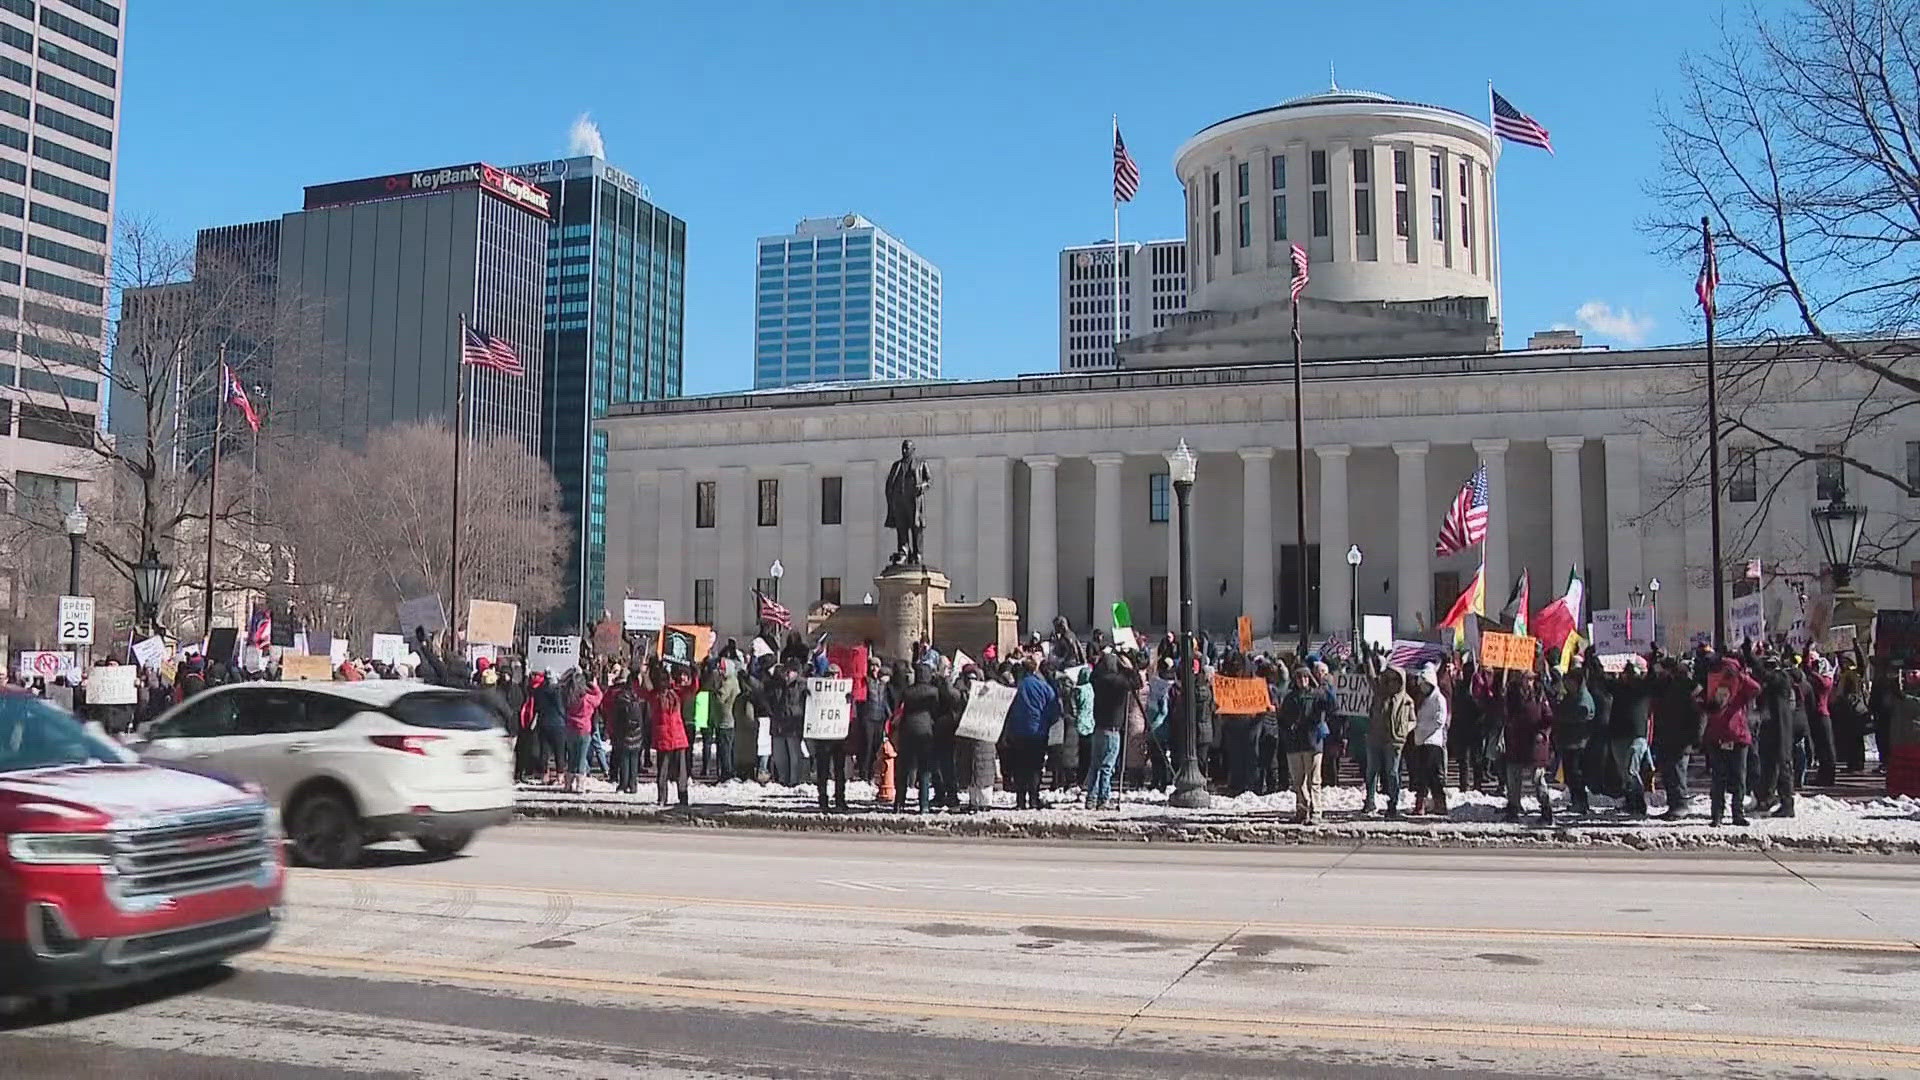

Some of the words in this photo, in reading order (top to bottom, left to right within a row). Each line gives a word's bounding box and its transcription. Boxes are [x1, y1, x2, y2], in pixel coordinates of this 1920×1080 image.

[411, 165, 479, 191] KeyBank
[605, 167, 640, 194] CHASE
[502, 175, 549, 211] KeyBank
[63, 602, 91, 612] SPEED
[66, 612, 88, 621] LIMIT
[64, 621, 90, 639] 25
[537, 645, 572, 655] Persist.
[815, 681, 846, 692] OHIO
[1336, 693, 1371, 714] TRUM
[820, 709, 841, 720] FOR
